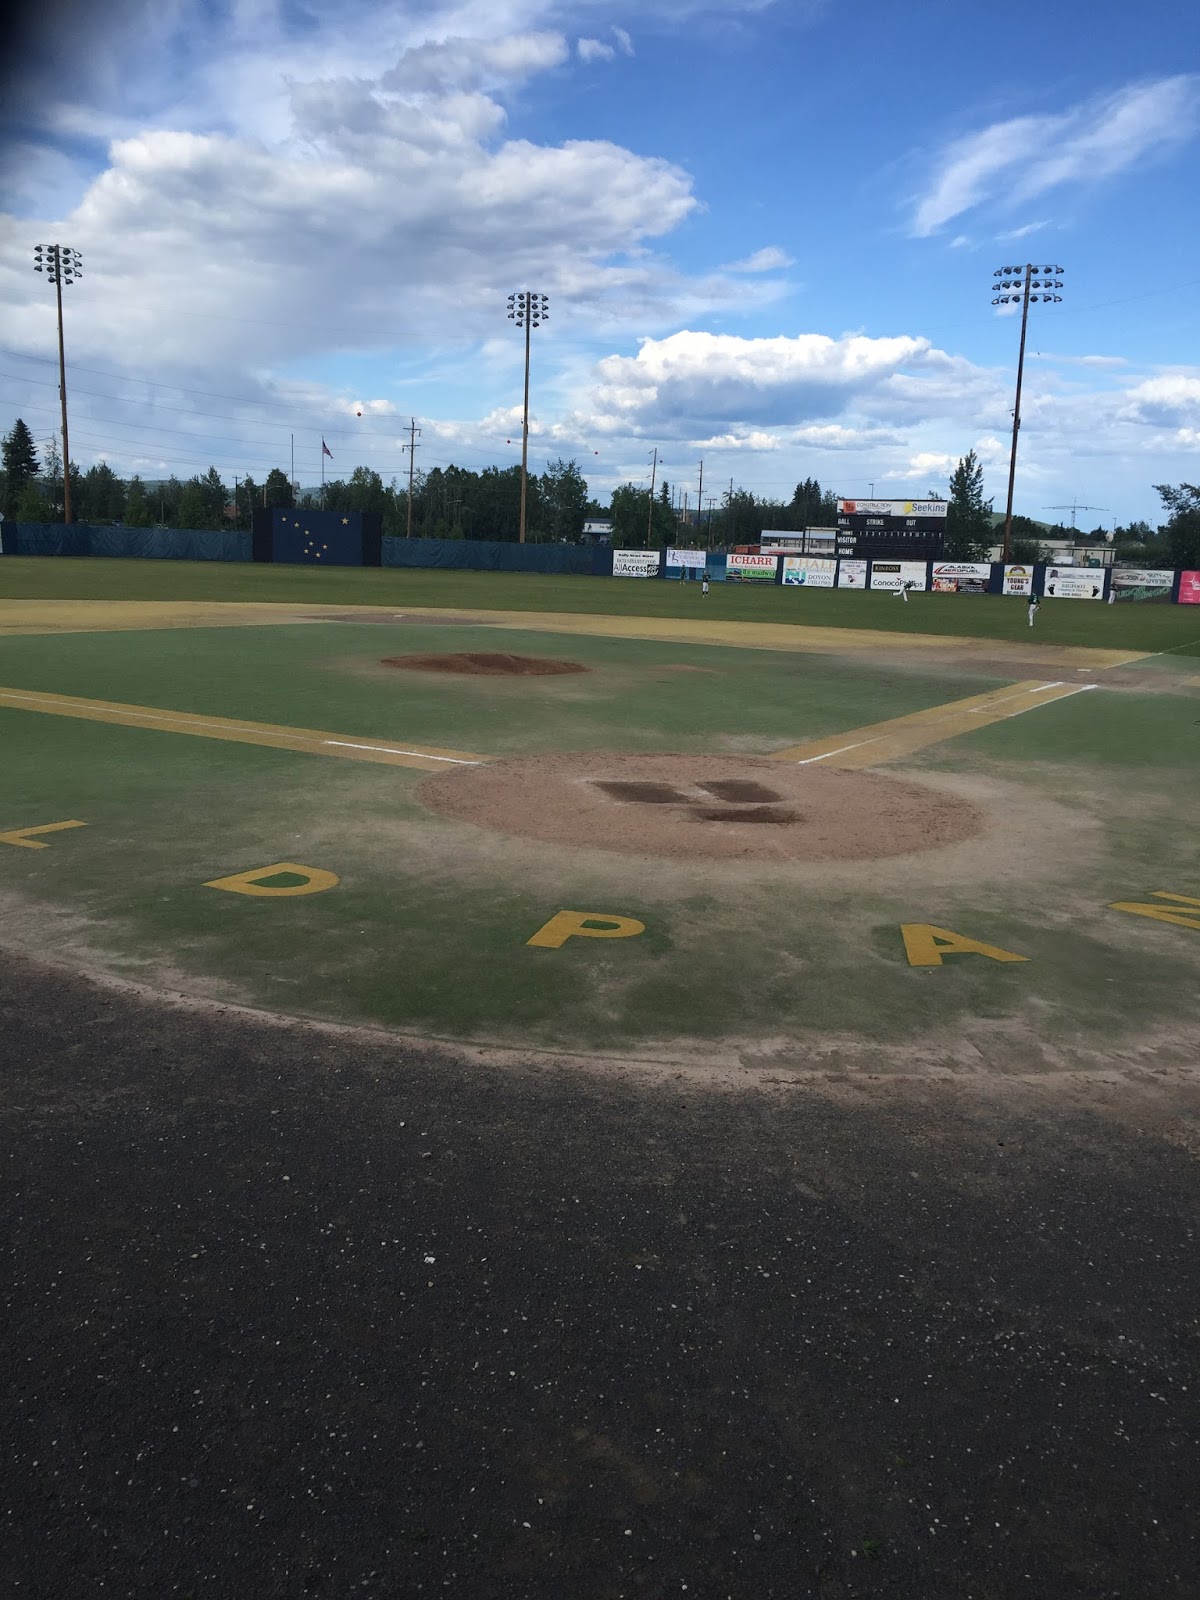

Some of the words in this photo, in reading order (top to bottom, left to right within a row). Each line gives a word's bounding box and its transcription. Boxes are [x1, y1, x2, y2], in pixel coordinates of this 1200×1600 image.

[912, 502, 946, 512] Seekins
[866, 518, 884, 526] STRIKE
[837, 536, 857, 544] VISITOR
[730, 555, 773, 566] ICHARR
[799, 559, 836, 569] HALE
